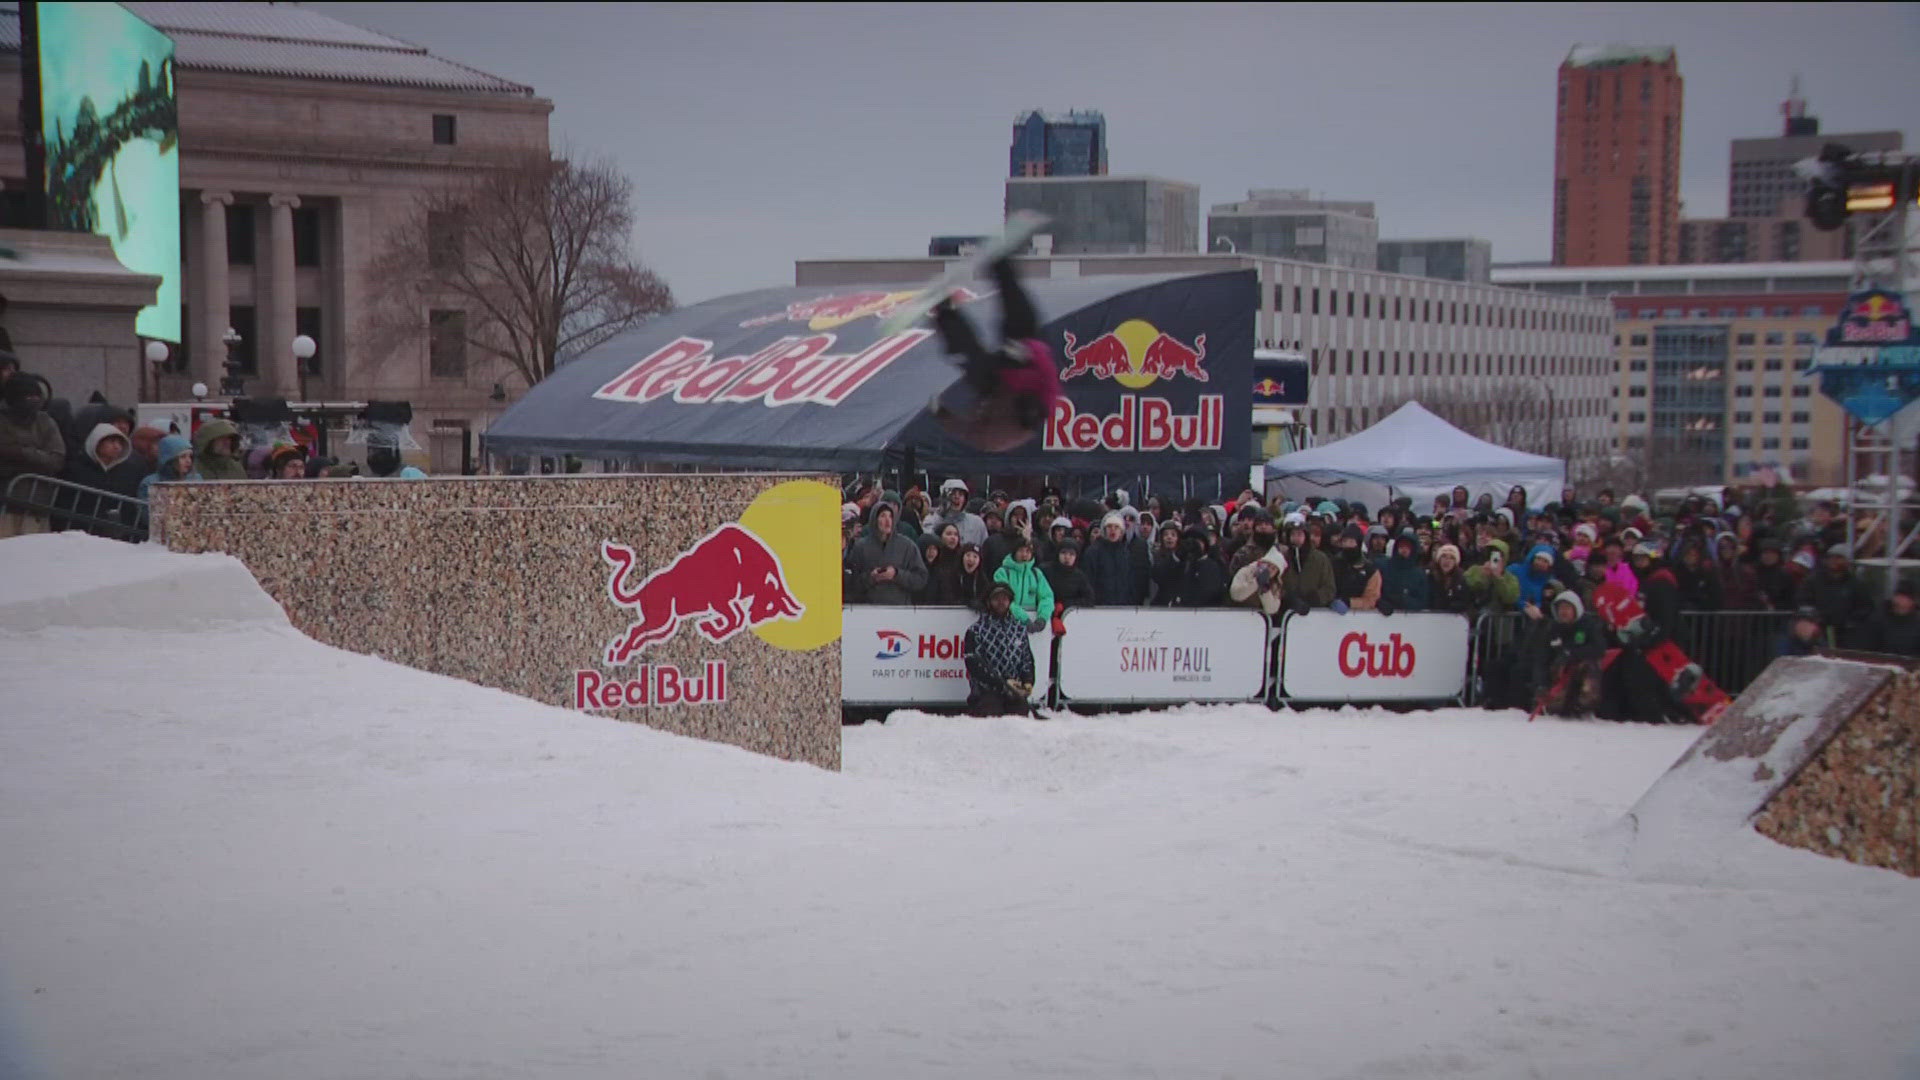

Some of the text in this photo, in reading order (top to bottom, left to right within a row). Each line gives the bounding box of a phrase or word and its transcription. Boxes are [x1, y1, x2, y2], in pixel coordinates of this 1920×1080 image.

[711, 329, 936, 407] Bull
[1043, 395, 1223, 451] Red Bull
[872, 669, 895, 678] PART
[898, 669, 911, 678] OF
[914, 669, 931, 678] THE
[933, 669, 964, 679] CIRCLE
[1120, 646, 1211, 672] SAINT PAUL
[1338, 632, 1416, 678] Cub
[575, 661, 727, 710] Red Bull
